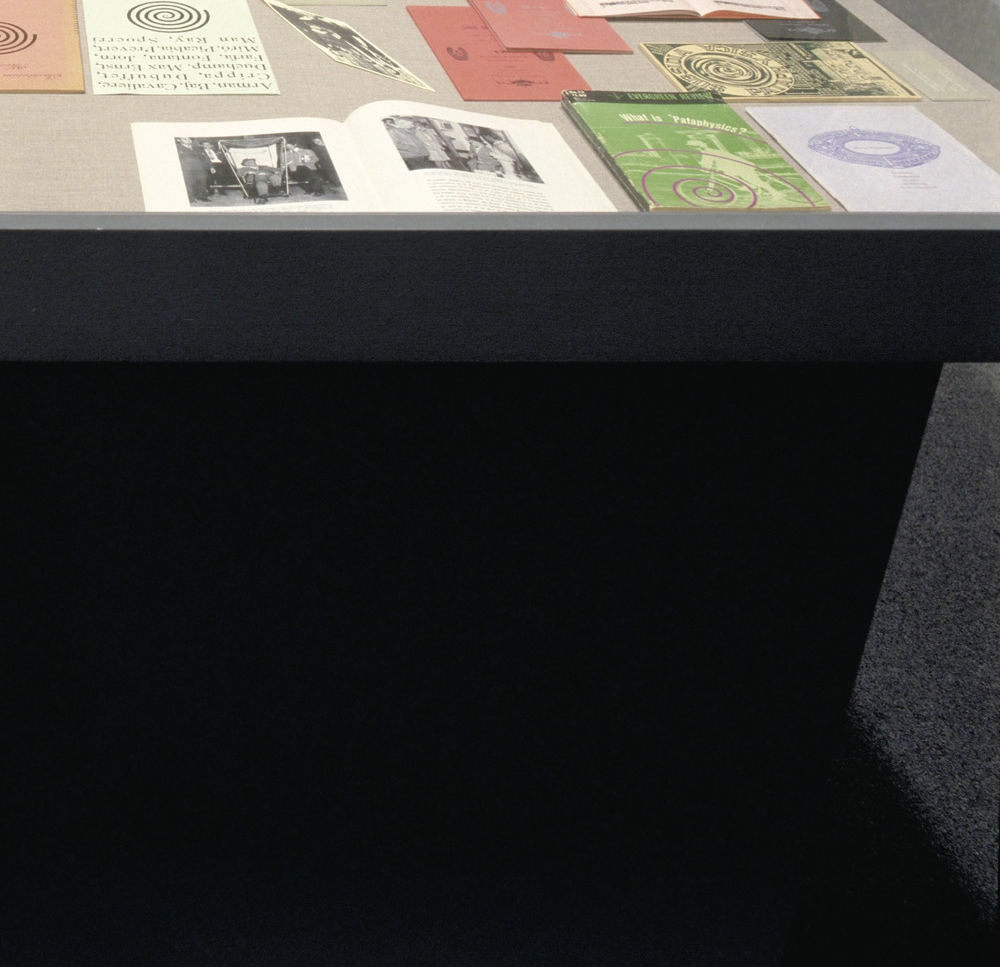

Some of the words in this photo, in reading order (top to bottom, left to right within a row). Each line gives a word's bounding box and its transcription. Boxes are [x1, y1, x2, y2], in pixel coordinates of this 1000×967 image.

[95, 63, 142, 71] Ernst,
[188, 62, 266, 71] Duchamp,
[96, 72, 188, 80] Dubuffet,
[98, 81, 177, 90] Cavaliere,
[180, 81, 209, 90] Baj,
[213, 82, 272, 90] Arman,
[619, 114, 649, 122] What
